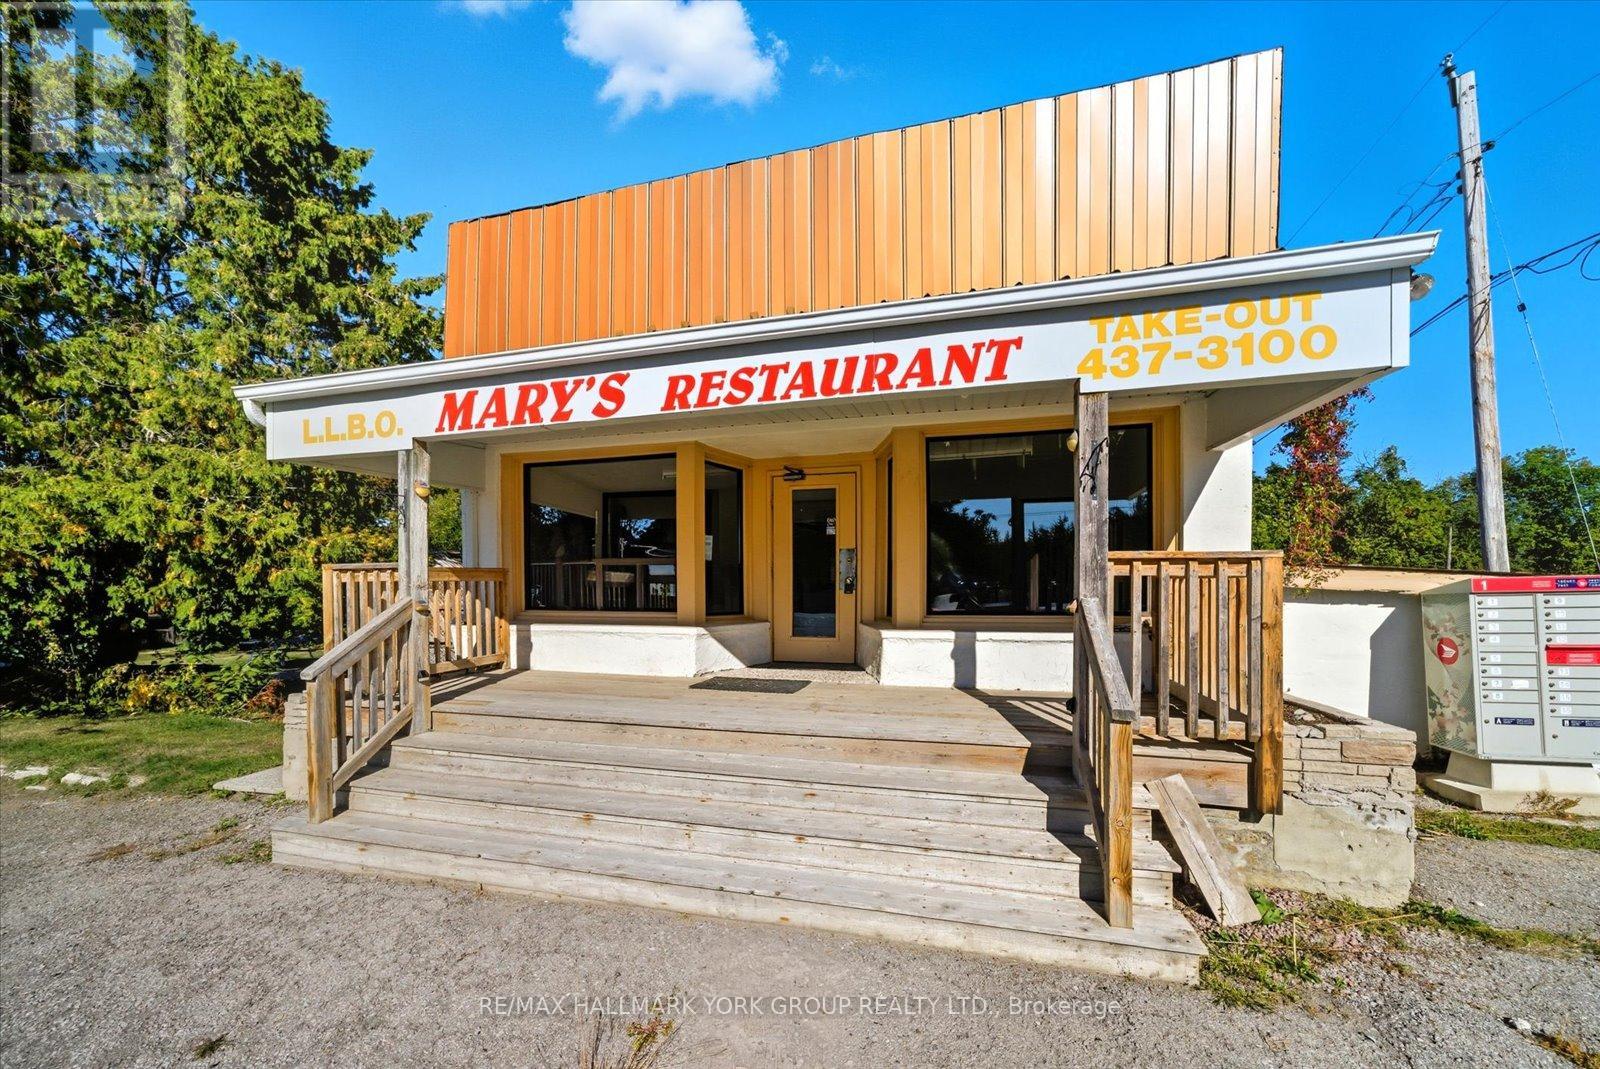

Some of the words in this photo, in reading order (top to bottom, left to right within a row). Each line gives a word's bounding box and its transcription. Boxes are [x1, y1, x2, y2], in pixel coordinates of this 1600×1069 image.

[1089, 290, 1322, 344] TAKE-OUT
[1076, 324, 1338, 380] 437-3100
[435, 372, 630, 433] MARY'S
[660, 336, 1023, 412] RESTAURANT
[302, 410, 404, 445] L.L.B.O.
